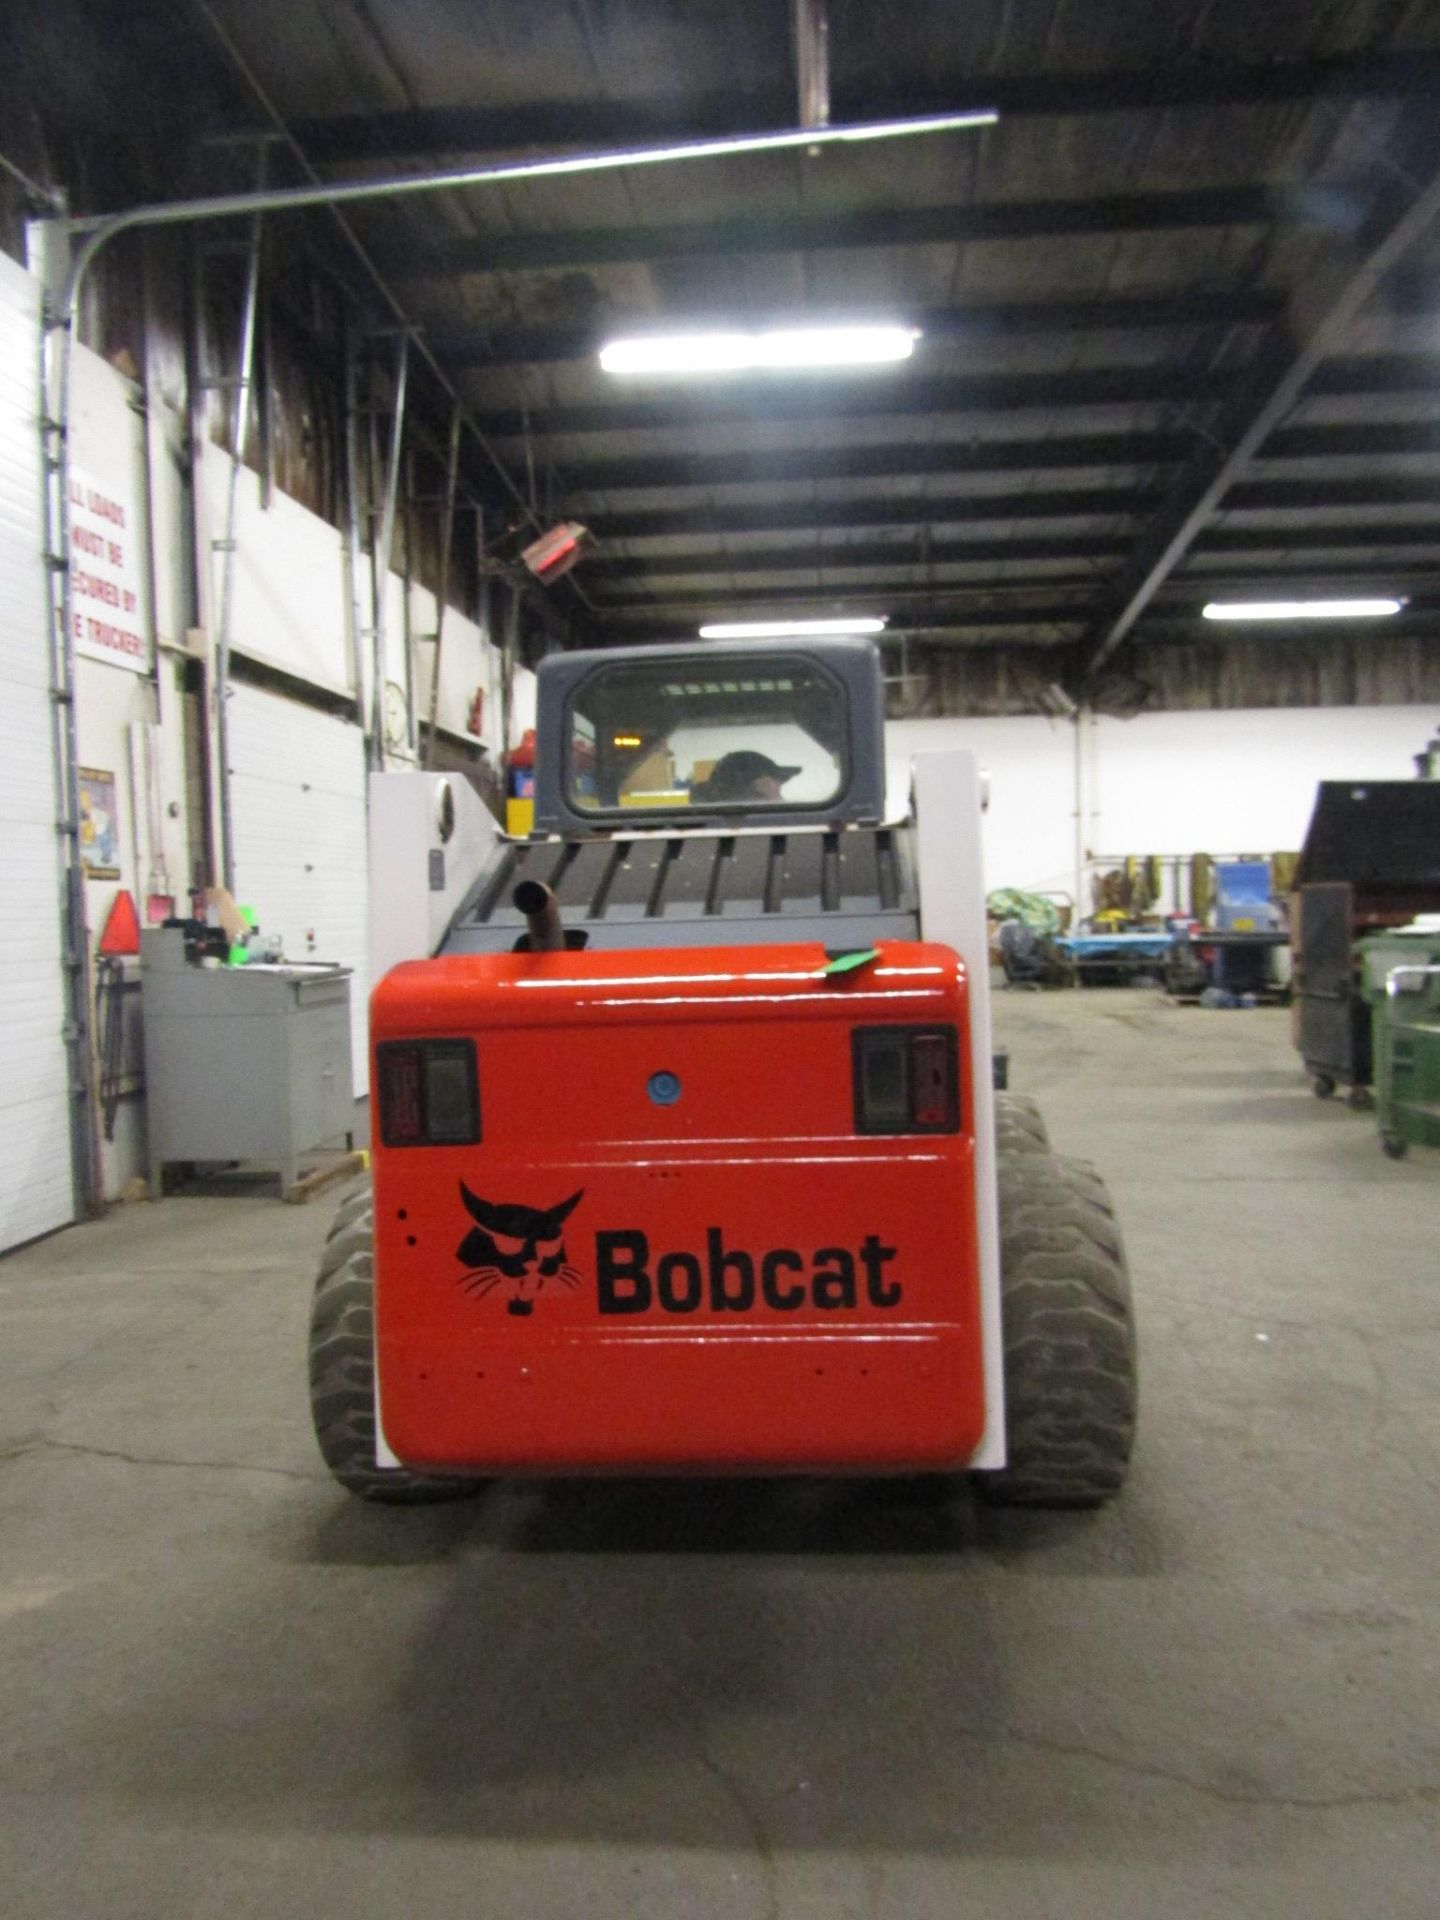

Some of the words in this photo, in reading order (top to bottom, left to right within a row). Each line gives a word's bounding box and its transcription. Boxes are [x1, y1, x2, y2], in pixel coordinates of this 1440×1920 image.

[87, 489, 125, 529] LOADS
[71, 525, 105, 559] MUST
[107, 540, 123, 568] BE
[70, 570, 119, 608] ECURED
[123, 589, 136, 614] BY
[595, 1226, 902, 1315] Bobcat
